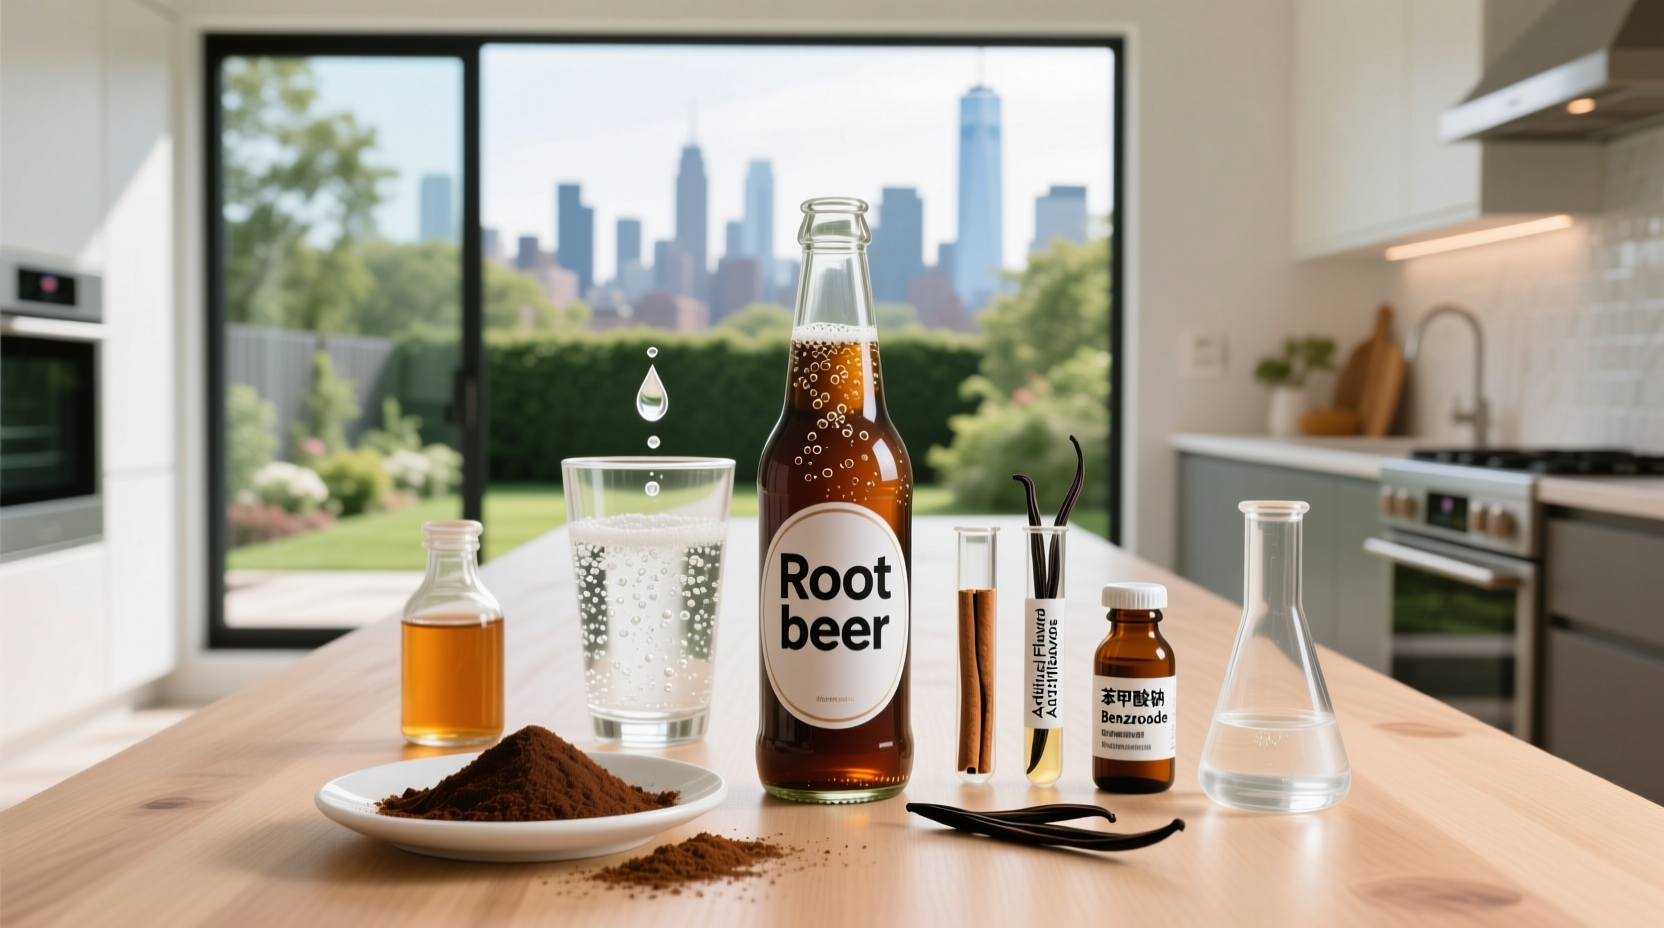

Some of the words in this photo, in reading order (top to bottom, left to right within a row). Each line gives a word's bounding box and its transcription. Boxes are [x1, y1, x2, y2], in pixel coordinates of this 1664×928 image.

[781, 553, 891, 600] Root
[781, 604, 889, 651] beer
[1101, 687, 1165, 708] 苯甲酸钠
